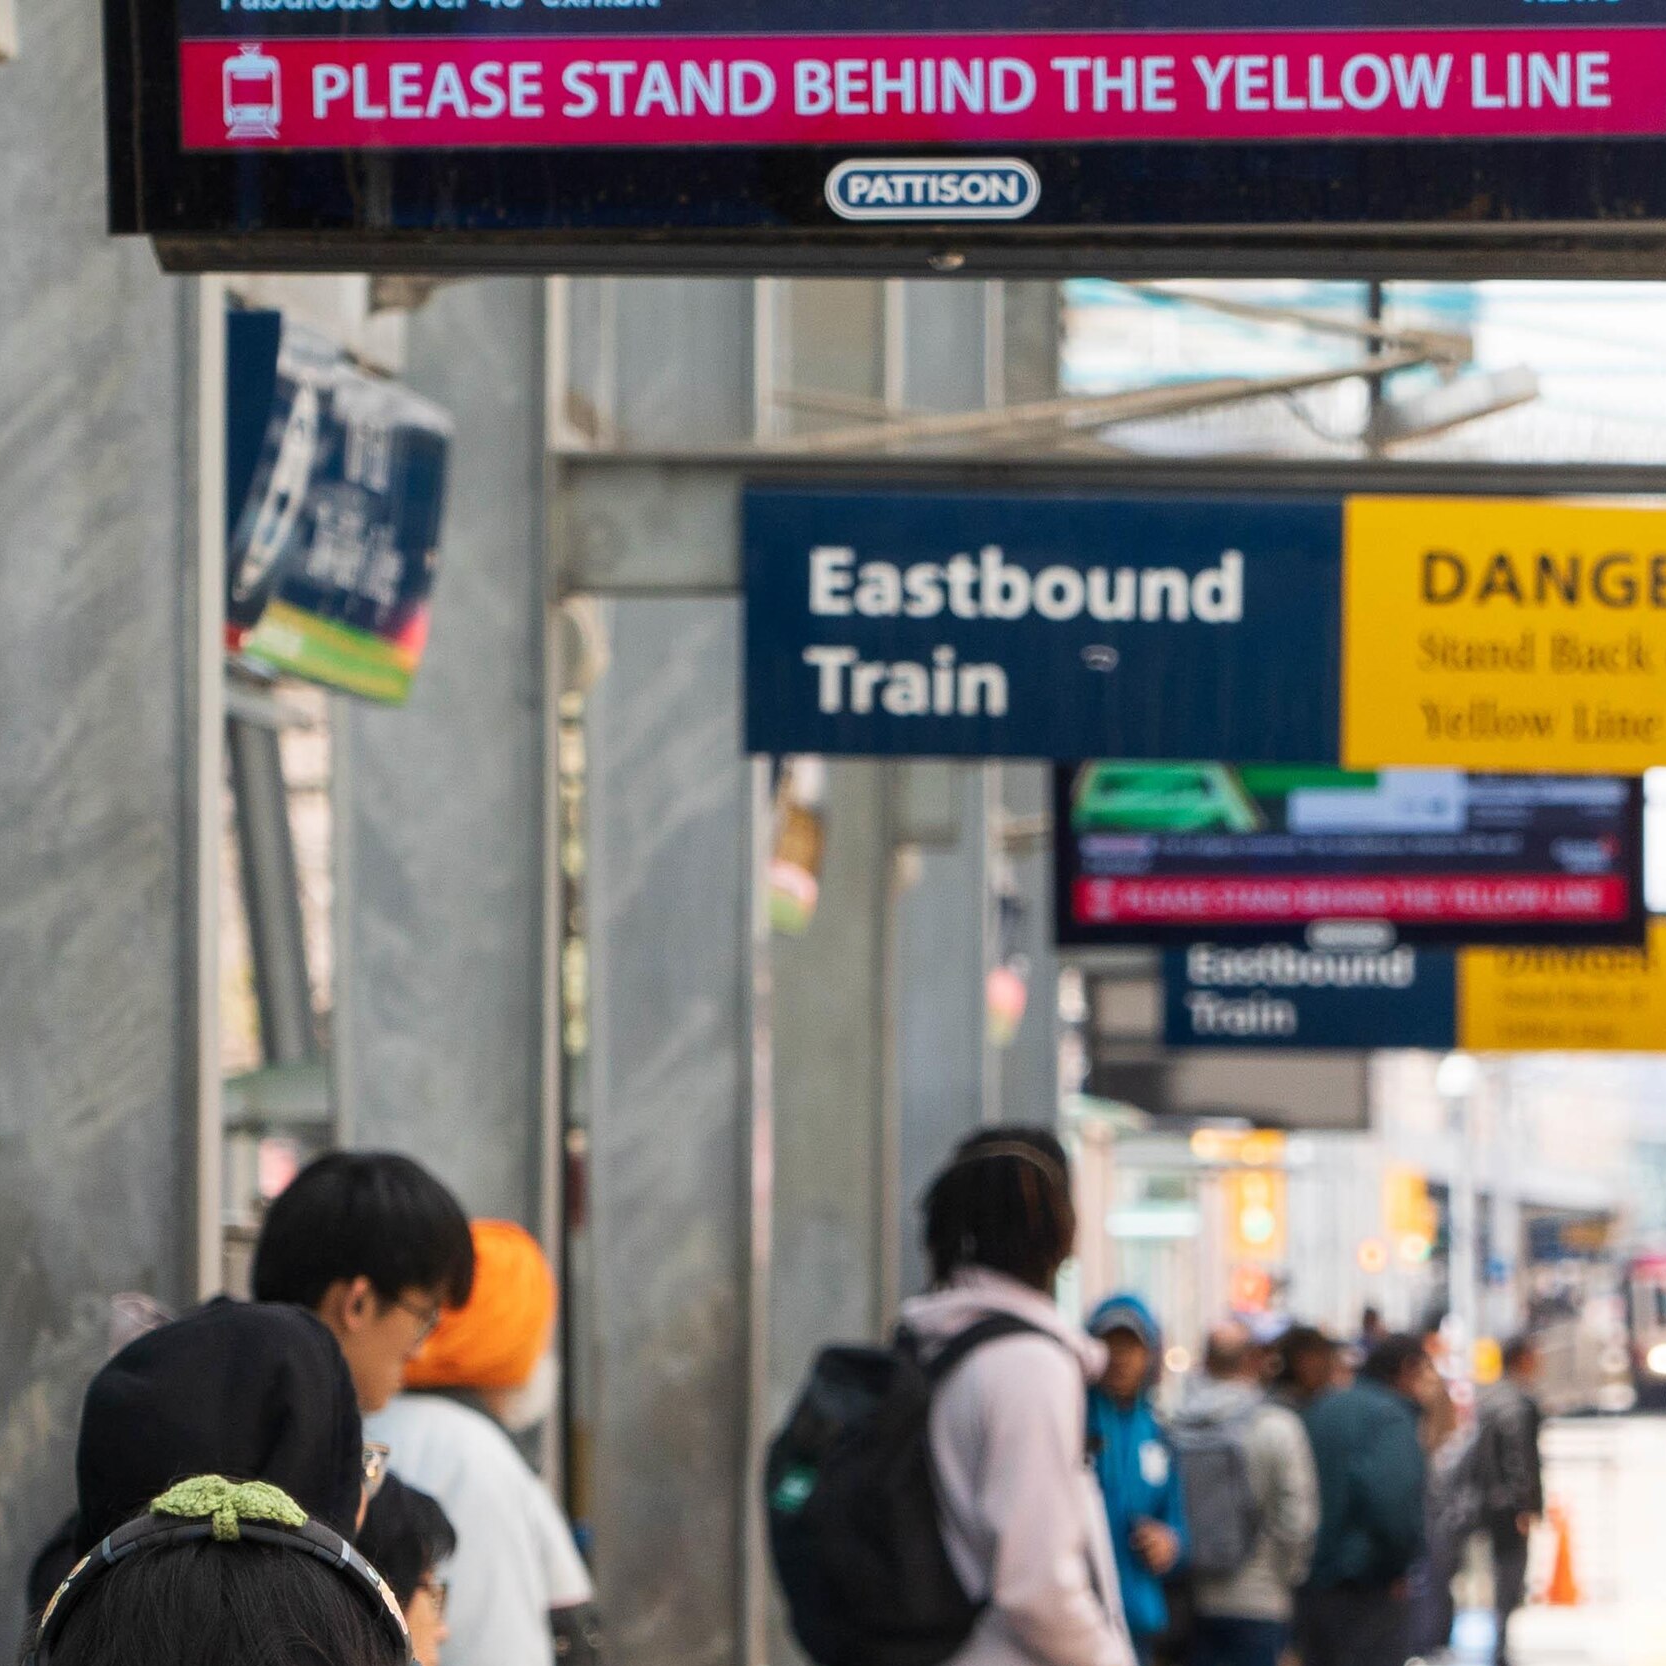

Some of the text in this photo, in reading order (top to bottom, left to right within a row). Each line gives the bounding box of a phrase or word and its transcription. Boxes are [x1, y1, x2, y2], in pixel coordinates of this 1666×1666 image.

[312, 51, 1611, 118] PLEASE STAND BEHIND THE YELLOW LINE
[847, 173, 1019, 204] PATTISON
[808, 544, 1245, 623] Eastbound
[1418, 627, 1536, 674] Stand
[1549, 628, 1653, 675] Back
[802, 644, 1008, 718] Train
[1419, 697, 1663, 744] Yellow Line
[1185, 943, 1415, 988] Eastbound
[1185, 990, 1297, 1035] Train
